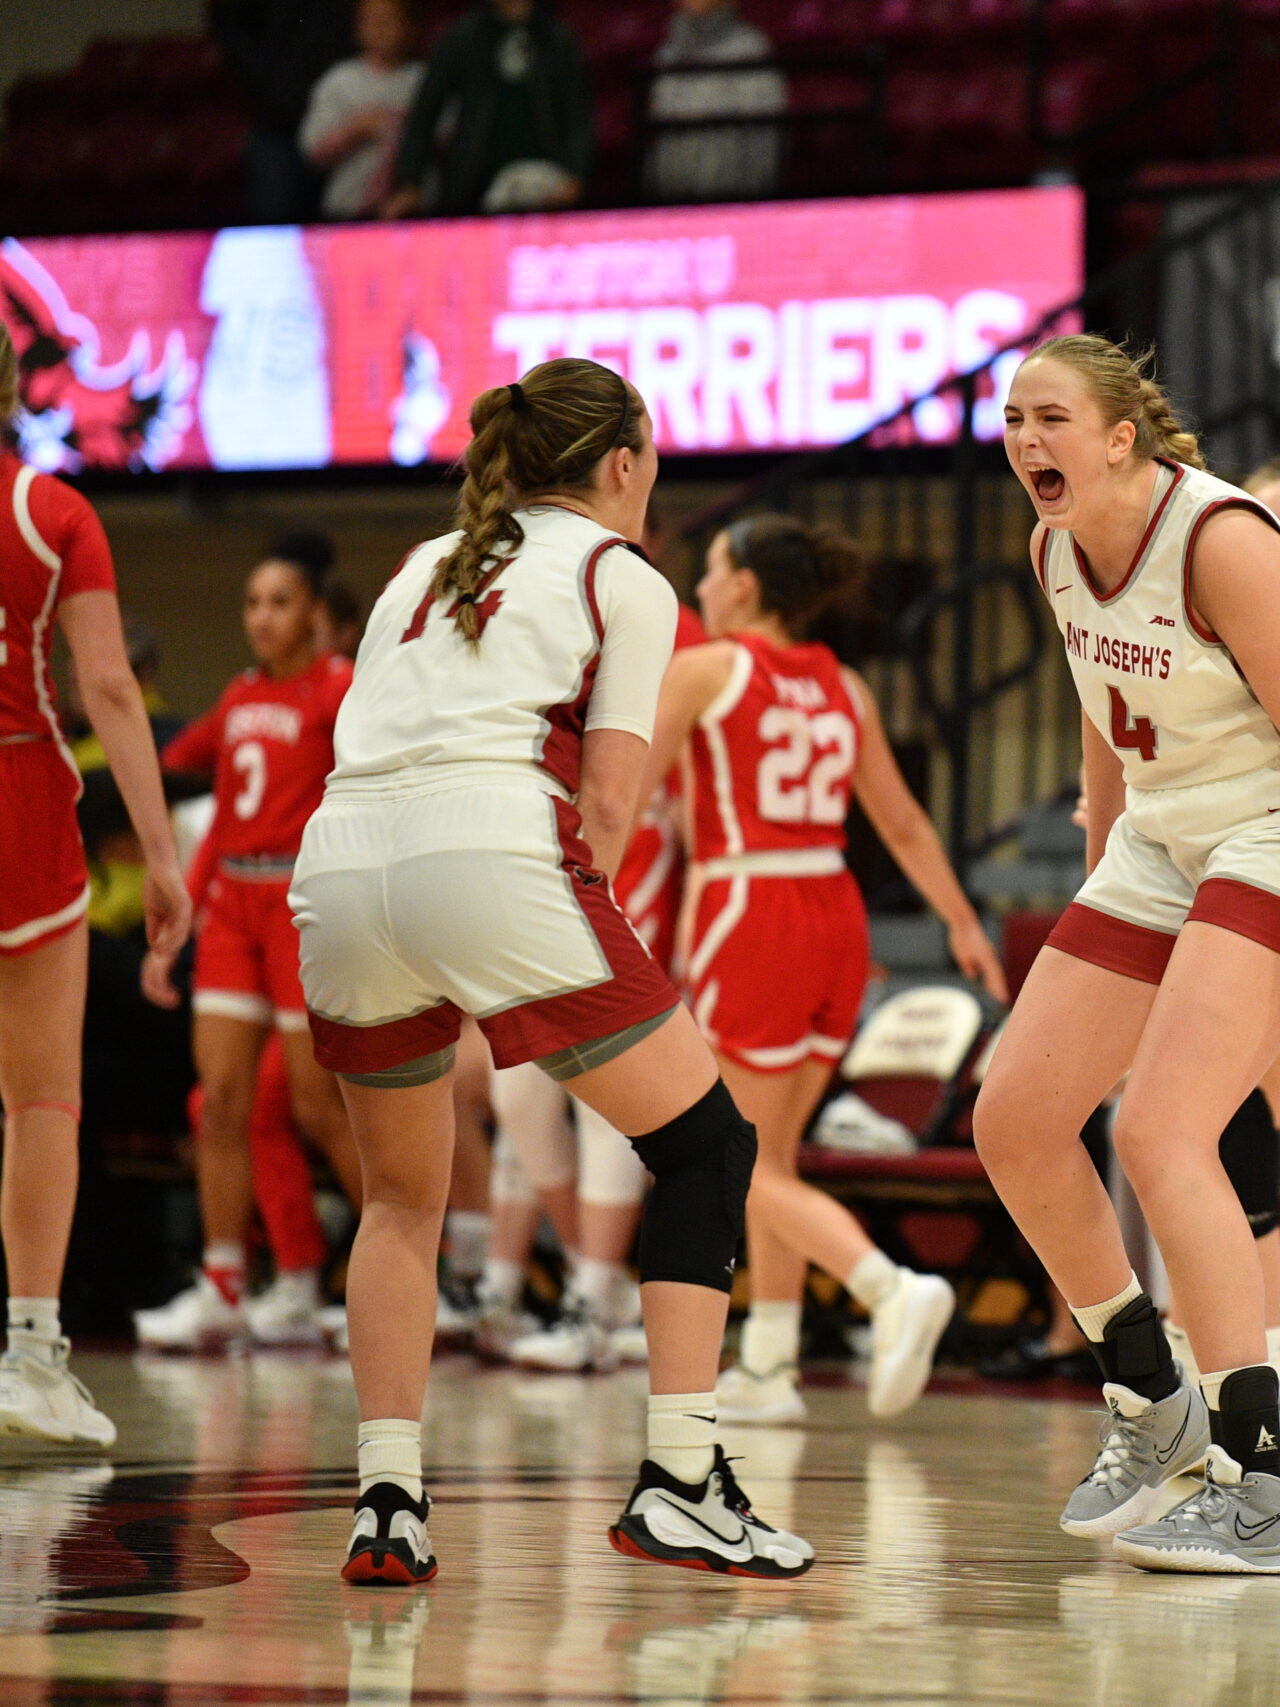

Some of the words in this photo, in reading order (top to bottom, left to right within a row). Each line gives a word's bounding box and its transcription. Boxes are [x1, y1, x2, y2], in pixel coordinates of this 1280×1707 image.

[1094, 634, 1172, 680] JOSEPH'S
[1105, 682, 1159, 763] 4
[234, 741, 266, 820] 3
[758, 705, 856, 825] 22
